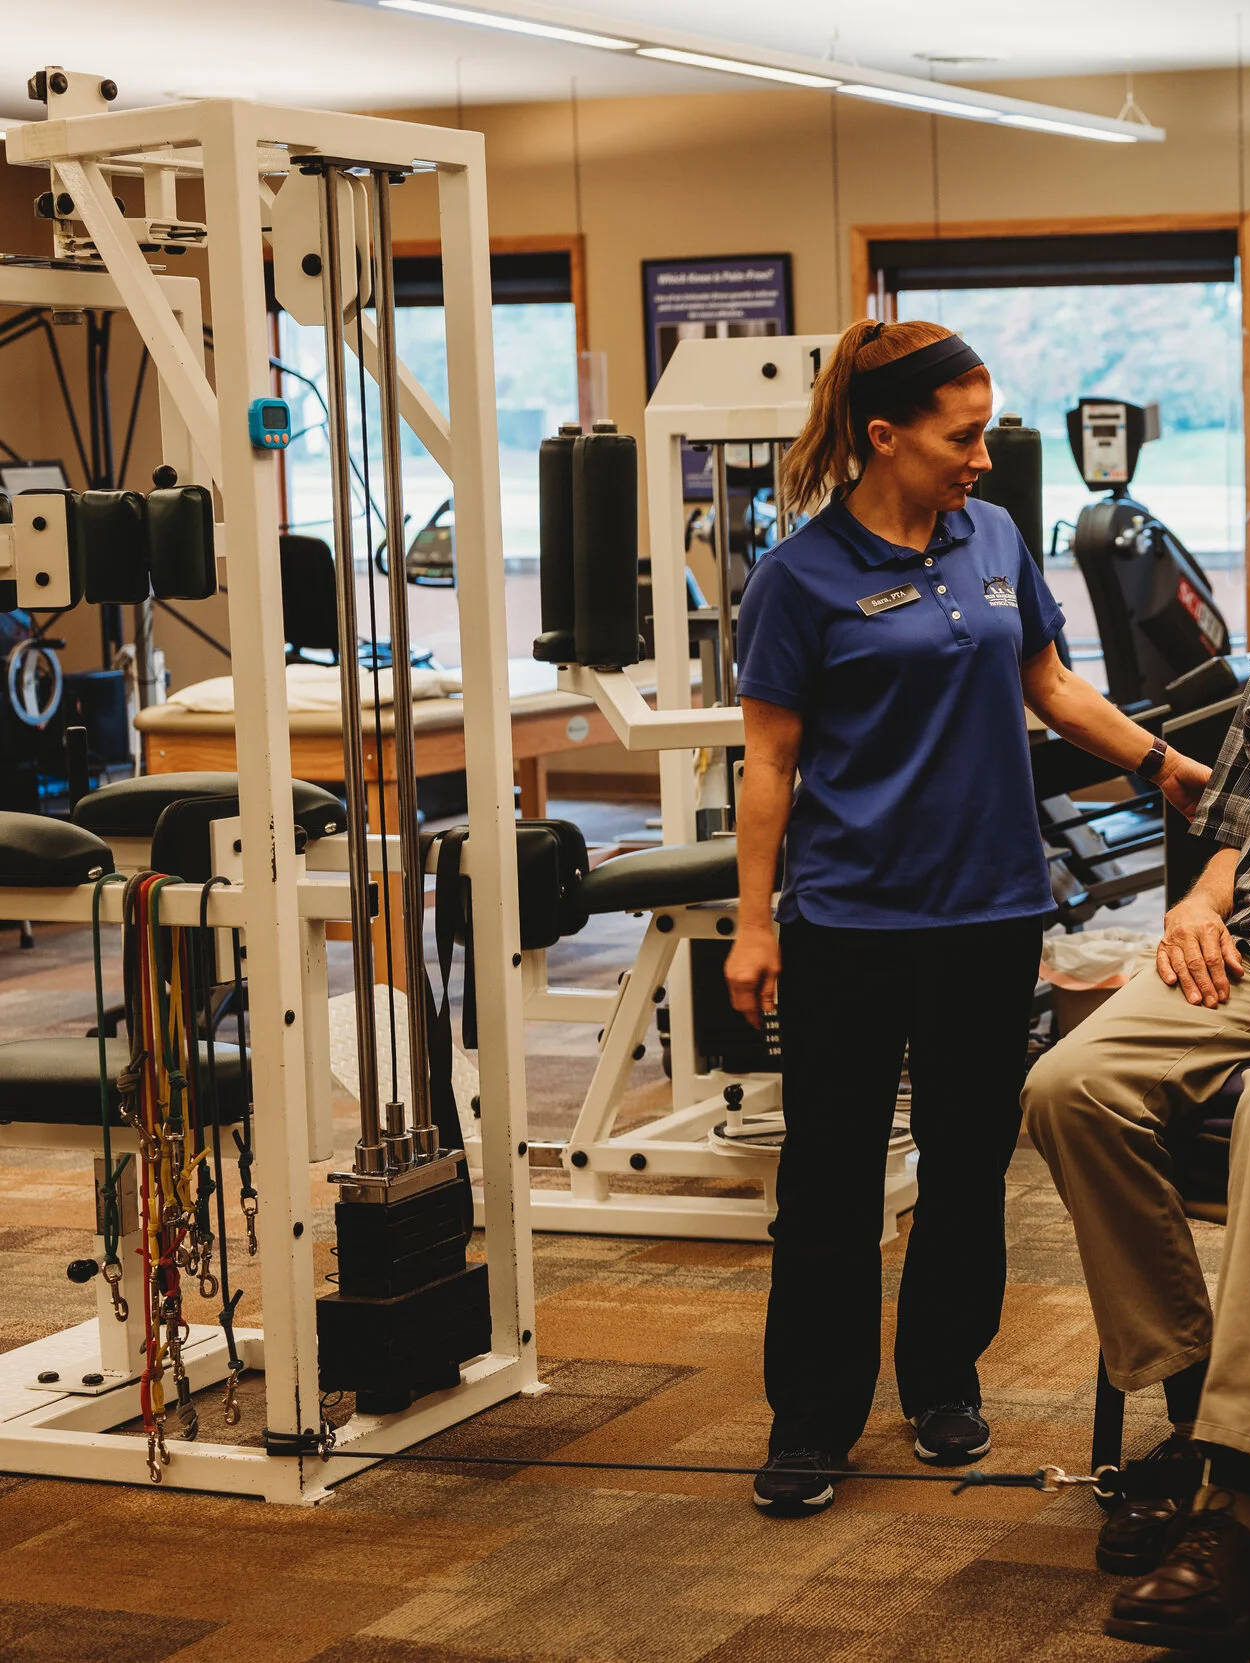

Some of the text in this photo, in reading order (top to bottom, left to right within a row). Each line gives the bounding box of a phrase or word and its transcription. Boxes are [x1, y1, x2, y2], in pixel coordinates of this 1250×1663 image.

[871, 590, 907, 607] Sara, PTA
[766, 1021, 780, 1030] 130
[766, 1035, 780, 1043] 140
